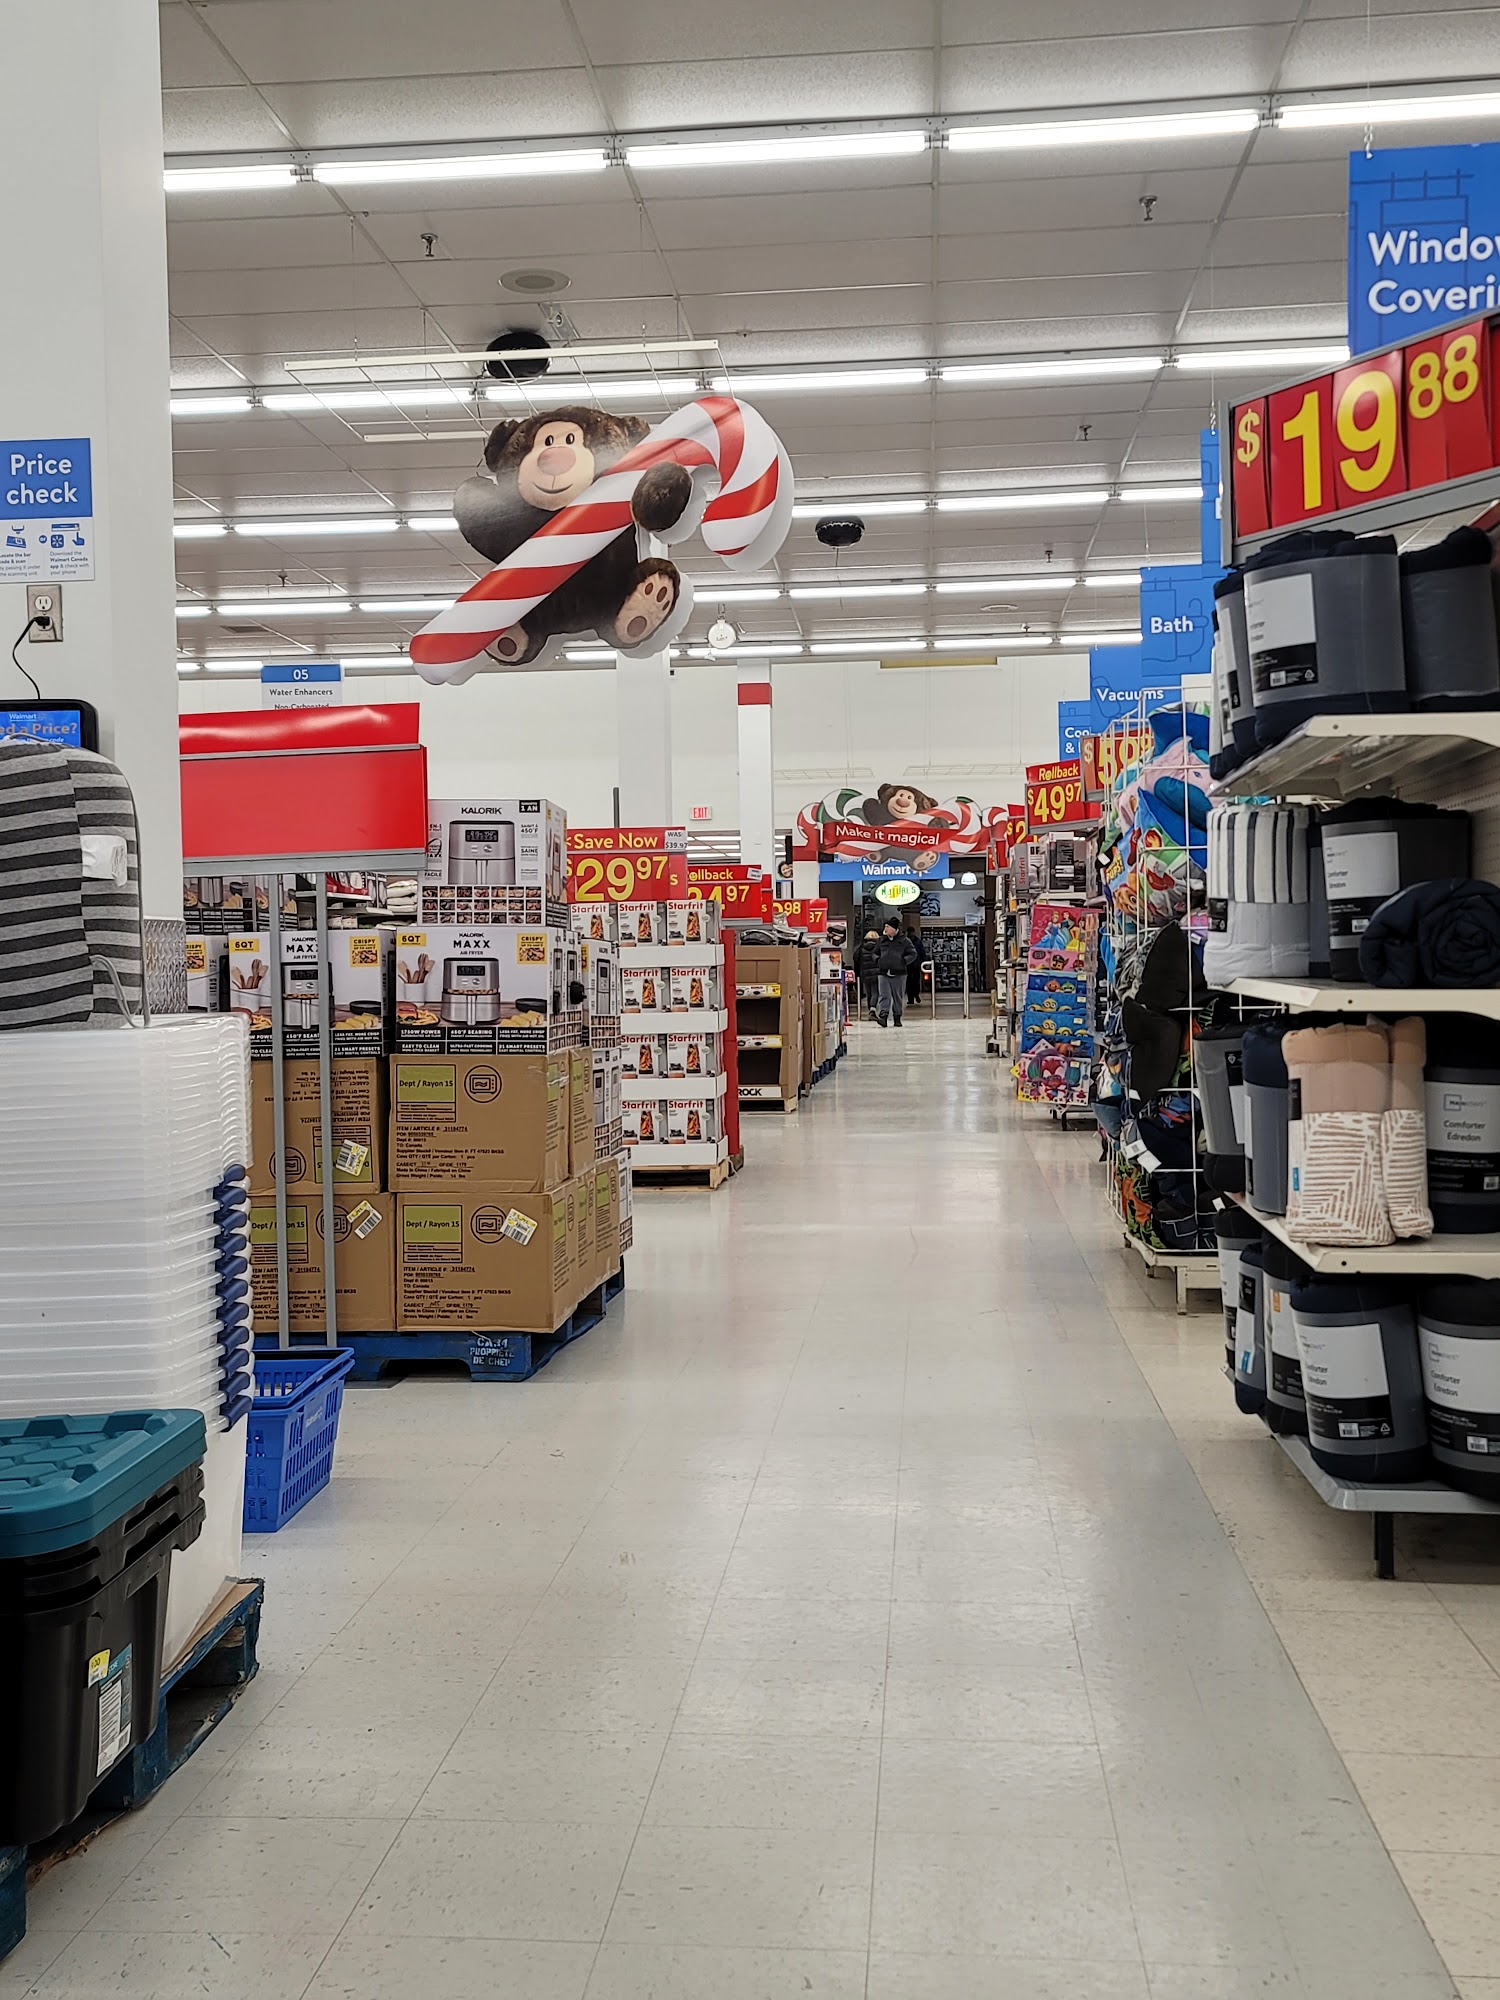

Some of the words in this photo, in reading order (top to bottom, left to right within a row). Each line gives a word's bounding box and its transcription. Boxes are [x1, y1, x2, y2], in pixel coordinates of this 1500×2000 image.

[1368, 274, 1500, 314] Coveri
[10, 453, 72, 476] Price
[6, 481, 78, 505] check
[1151, 615, 1193, 633] Bath
[293, 669, 309, 680] 05
[295, 688, 333, 696] Enhancers
[1097, 688, 1164, 702] Vacuums
[32, 722, 77, 734] Price?
[1039, 763, 1079, 781] Rollback
[693, 807, 707, 818] EXIT
[836, 824, 871, 838] Make
[875, 829, 886, 840] it
[888, 832, 940, 846] magical
[574, 833, 614, 850] Save
[619, 832, 658, 849] Now
[665, 841, 688, 849] $39.97
[862, 864, 911, 876] Walmart
[572, 905, 607, 914] Starfrit
[619, 903, 655, 912] Starfrit
[668, 901, 704, 910] Starfrit
[453, 940, 491, 949] MAXX
[623, 968, 659, 978] Starfrit
[671, 967, 707, 976] Starfrit
[620, 1034, 656, 1043] Starfrit
[668, 1033, 704, 1042] Starfrit
[422, 1080, 443, 1088] Rayon
[737, 1088, 762, 1096] ROCK
[621, 1101, 657, 1110] Starfrit
[668, 1100, 704, 1109] Starfrit
[1443, 1120, 1486, 1130] Comforter
[252, 1222, 268, 1230] Dept
[473, 1356, 485, 1365] DE
[488, 1358, 510, 1366] CHEP
